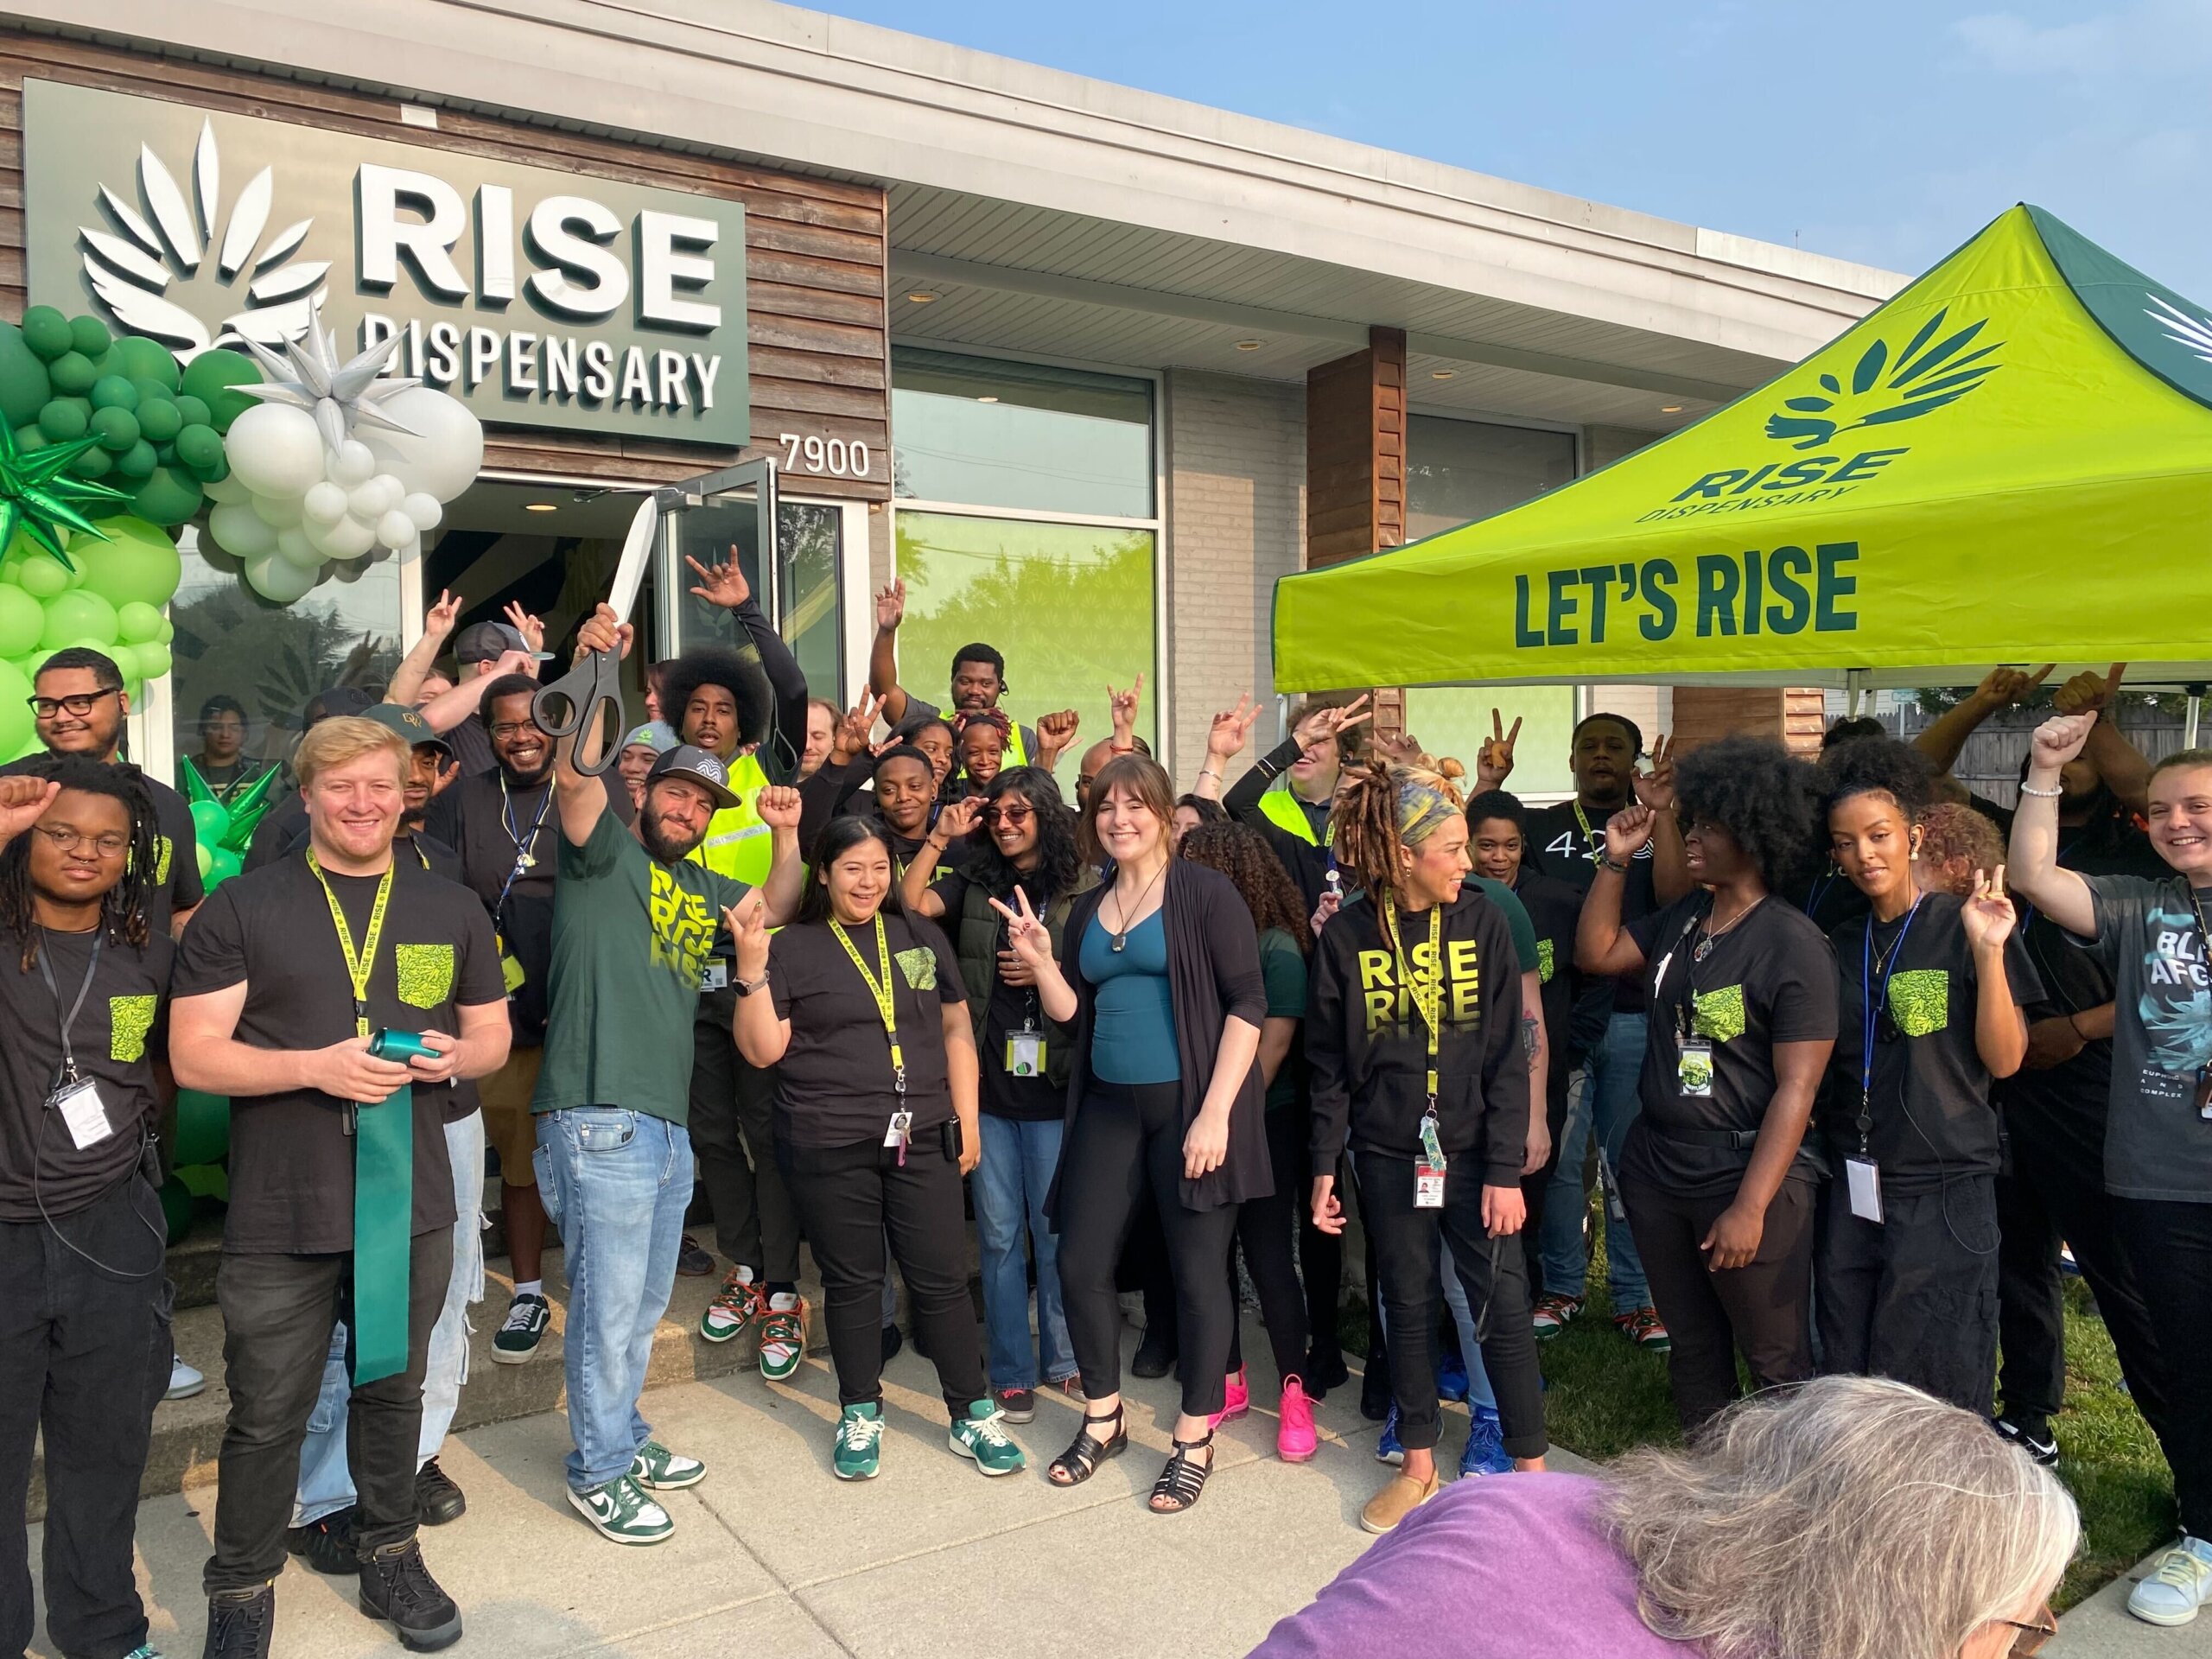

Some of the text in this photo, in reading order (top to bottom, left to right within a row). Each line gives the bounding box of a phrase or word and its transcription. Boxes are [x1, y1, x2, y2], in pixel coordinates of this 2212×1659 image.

[359, 162, 722, 330] RISE
[363, 312, 722, 410] DISPENSARY
[779, 432, 869, 477] 7900
[1669, 447, 1912, 503] RISE
[1634, 485, 1860, 524] DISPENSARY
[1515, 541, 1859, 648] LET'S RISE
[340, 927, 351, 945] RISE
[348, 957, 359, 976] RISE
[360, 877, 390, 976] RISE RISE RISE RISE
[835, 925, 881, 996] RISE RISE RISE RISE
[1357, 939, 1479, 990] RISE
[1363, 980, 1481, 1031] RISE
[1411, 986, 1424, 1004] RISE
[2139, 1088, 2183, 1098] COMPLEX
